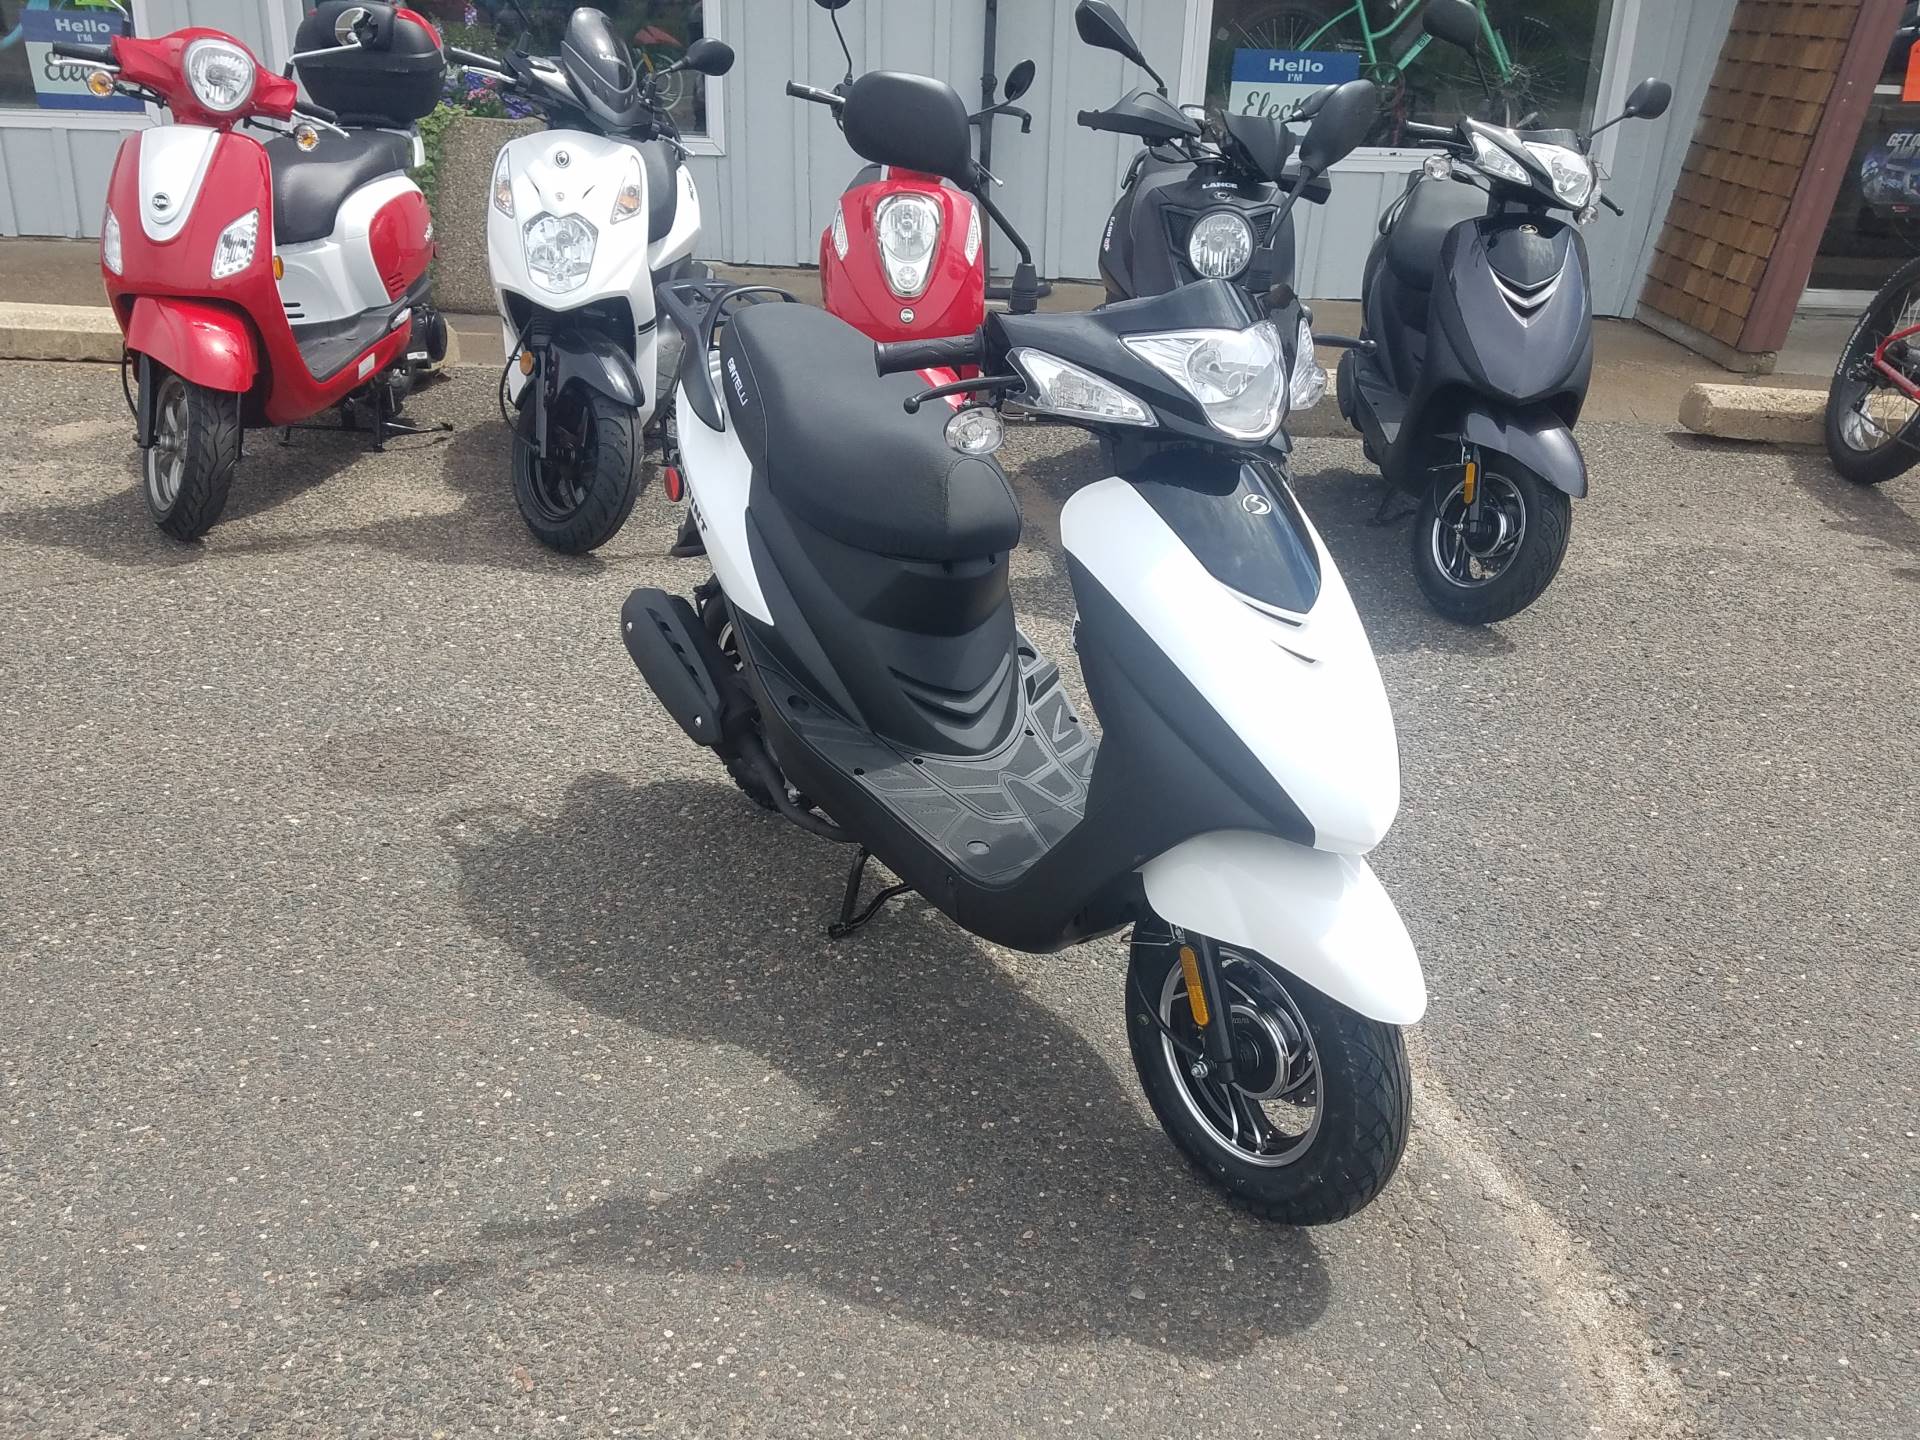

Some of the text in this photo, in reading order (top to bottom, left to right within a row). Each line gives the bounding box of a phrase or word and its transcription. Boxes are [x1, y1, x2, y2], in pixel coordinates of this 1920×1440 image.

[54, 18, 110, 33] Hello
[77, 33, 93, 42] I'M
[1268, 57, 1324, 73] Hello
[1287, 73, 1303, 82] I'M
[1886, 132, 1913, 147] GET
[1201, 181, 1238, 189] LANCE
[727, 356, 748, 407] BINTELLI
